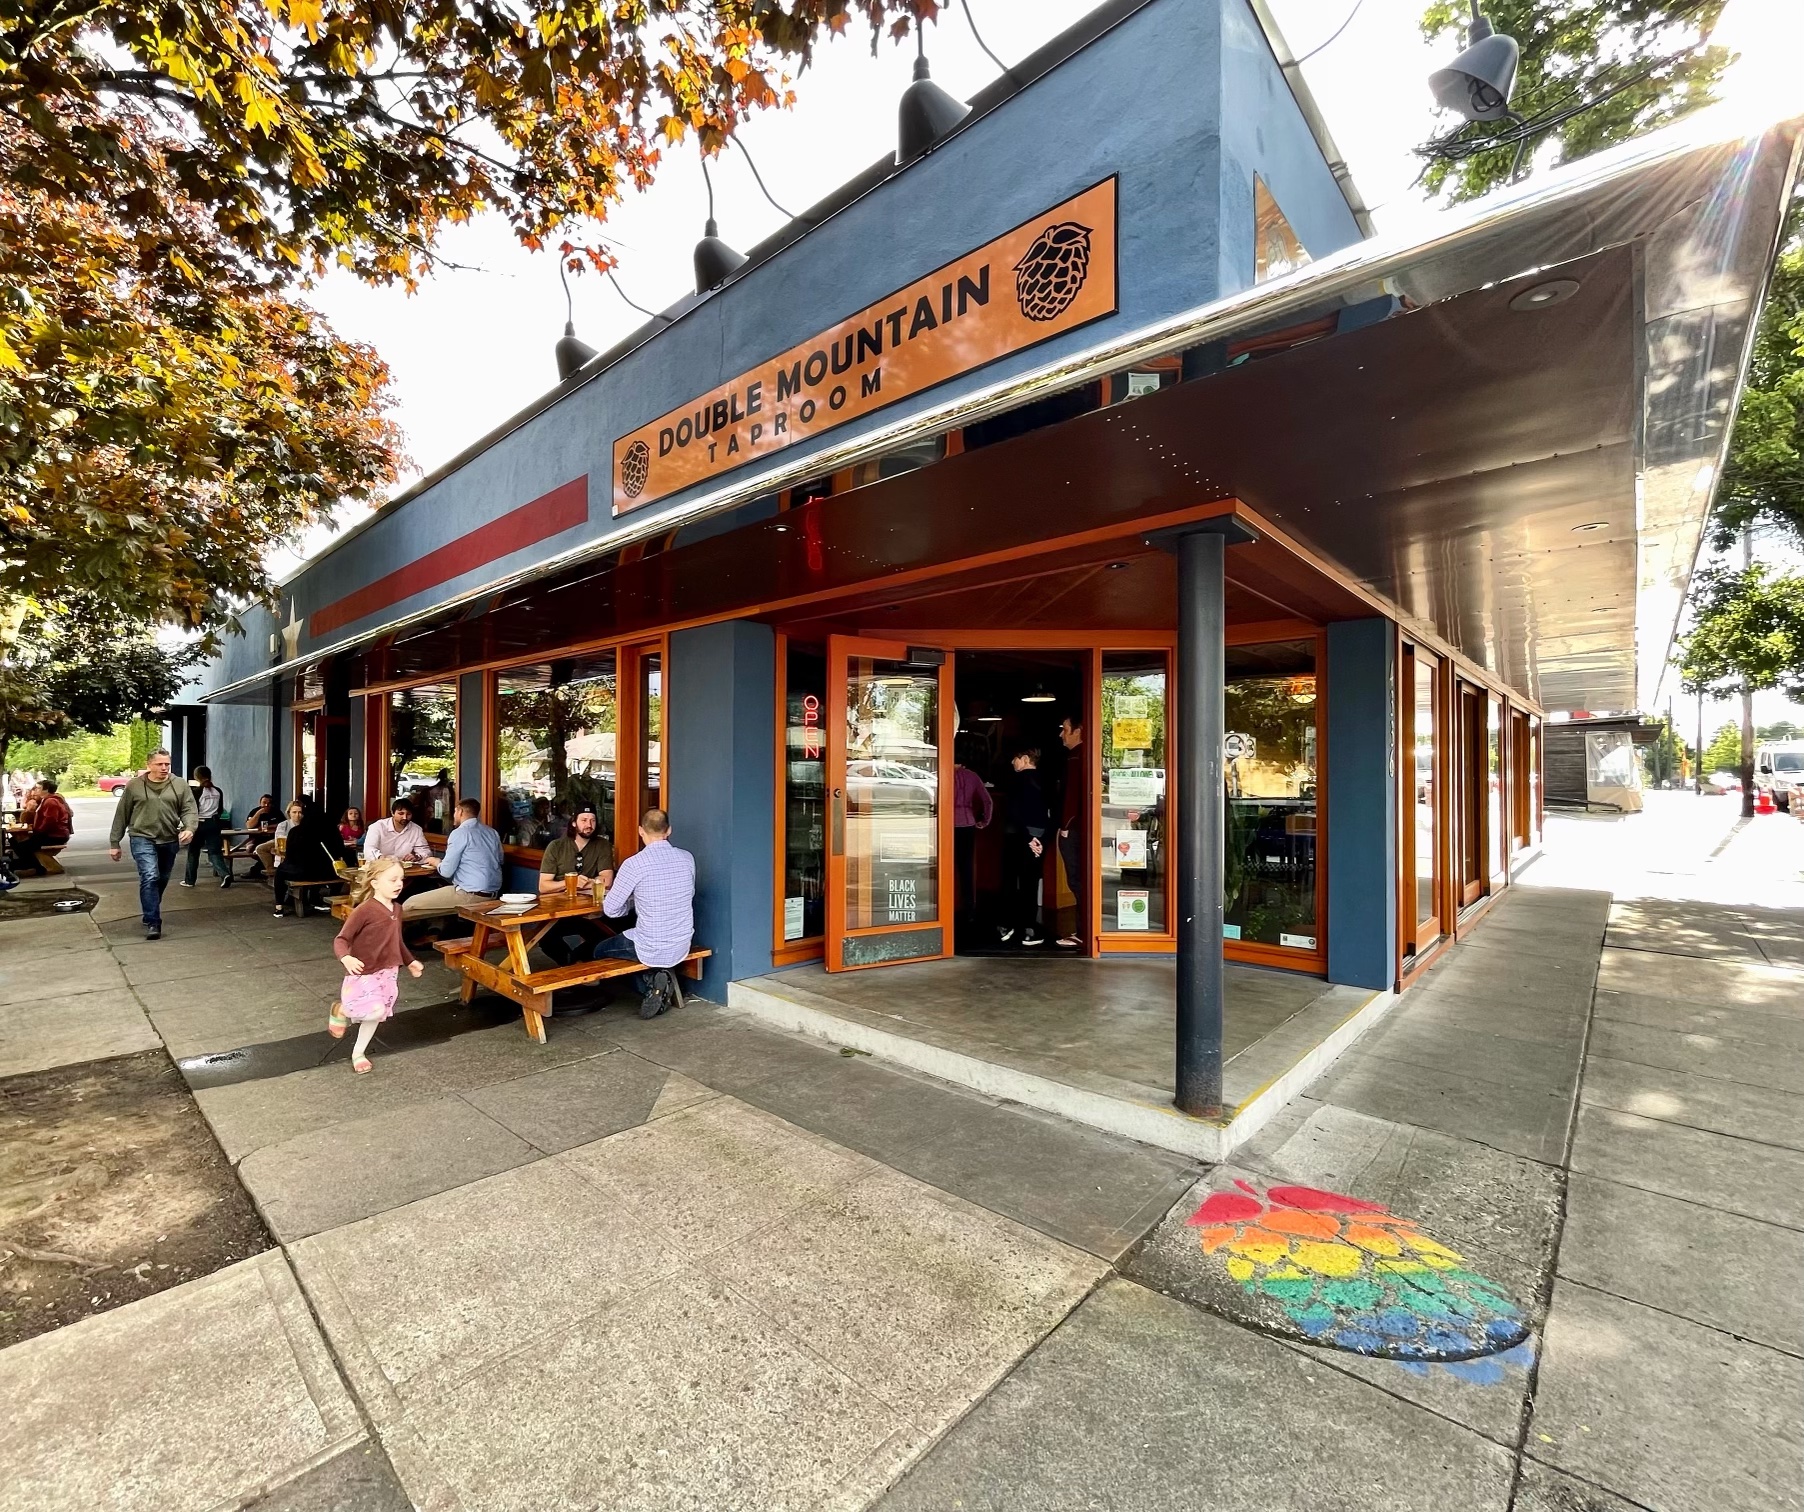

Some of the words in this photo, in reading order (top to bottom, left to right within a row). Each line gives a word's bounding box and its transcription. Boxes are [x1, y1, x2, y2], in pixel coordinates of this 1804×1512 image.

[659, 381, 762, 458] DOUBLE
[776, 263, 990, 403] MOUNTAIN
[708, 368, 882, 463] TAPROOM
[804, 695, 819, 759] OPEN
[888, 879, 916, 892] BLACK
[888, 893, 916, 909] LIVES
[888, 910, 916, 922] MATTER
